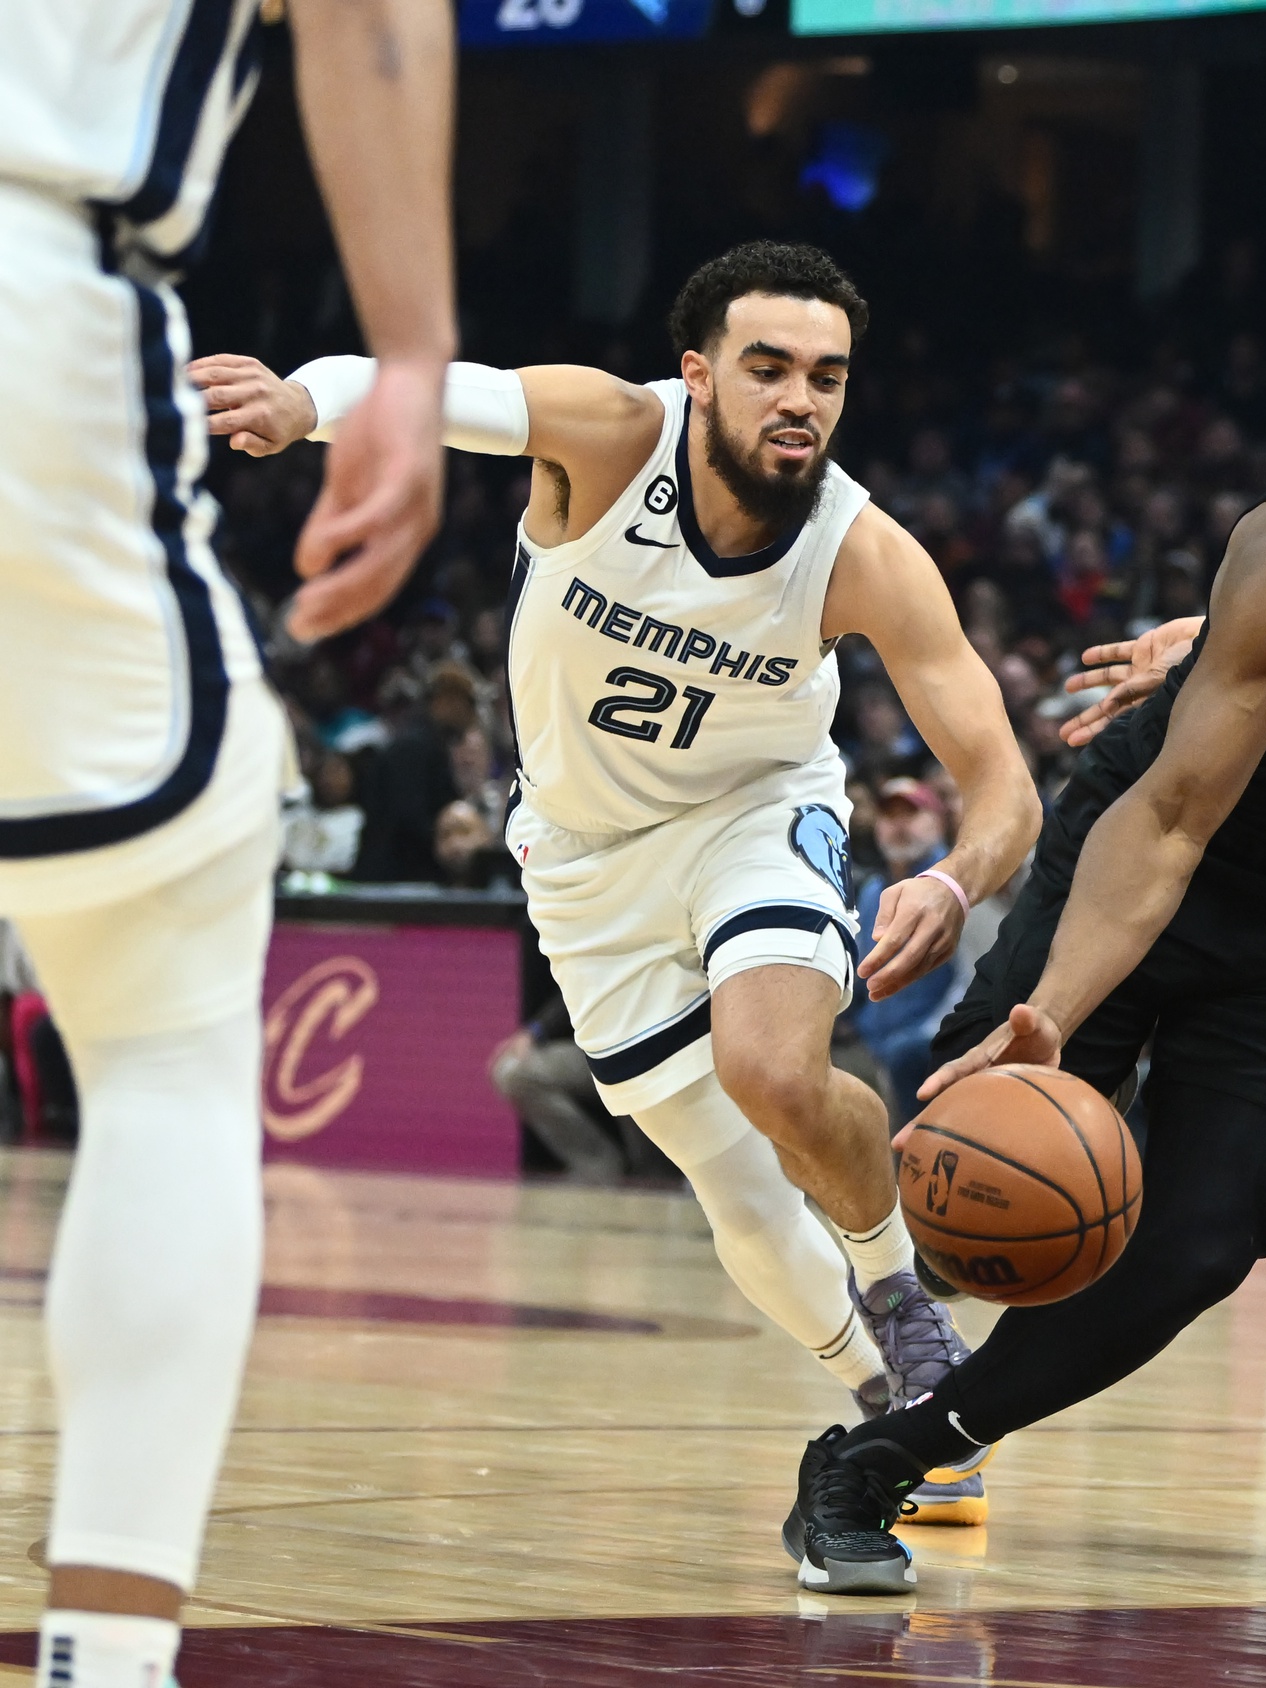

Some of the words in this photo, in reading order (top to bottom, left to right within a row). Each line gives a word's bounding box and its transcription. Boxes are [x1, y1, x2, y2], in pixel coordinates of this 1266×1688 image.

[648, 481, 674, 511] 6
[560, 576, 799, 687] MEMPHIS
[587, 666, 717, 750] 21
